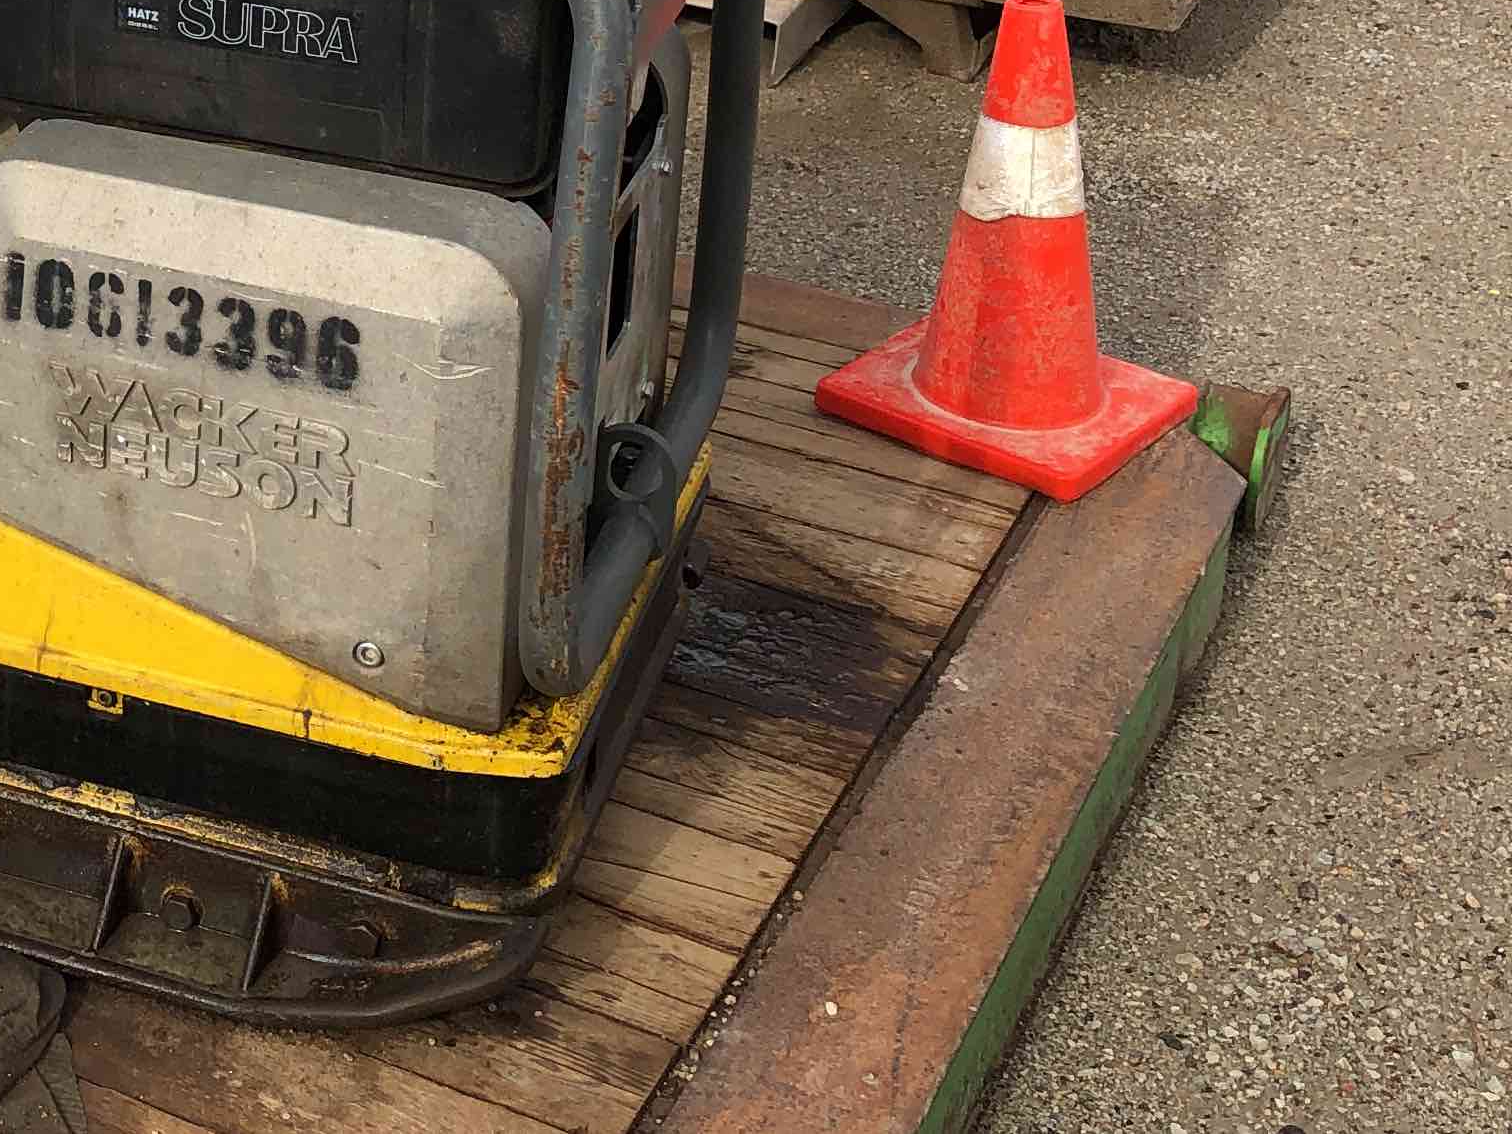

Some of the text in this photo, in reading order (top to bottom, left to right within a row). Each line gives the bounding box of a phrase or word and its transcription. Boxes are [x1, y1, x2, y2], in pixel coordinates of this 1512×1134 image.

[128, 6, 159, 22] HATZ
[1, 250, 362, 391] 10613396
[48, 361, 357, 478] WACKER
[56, 411, 355, 528] NEUSON
